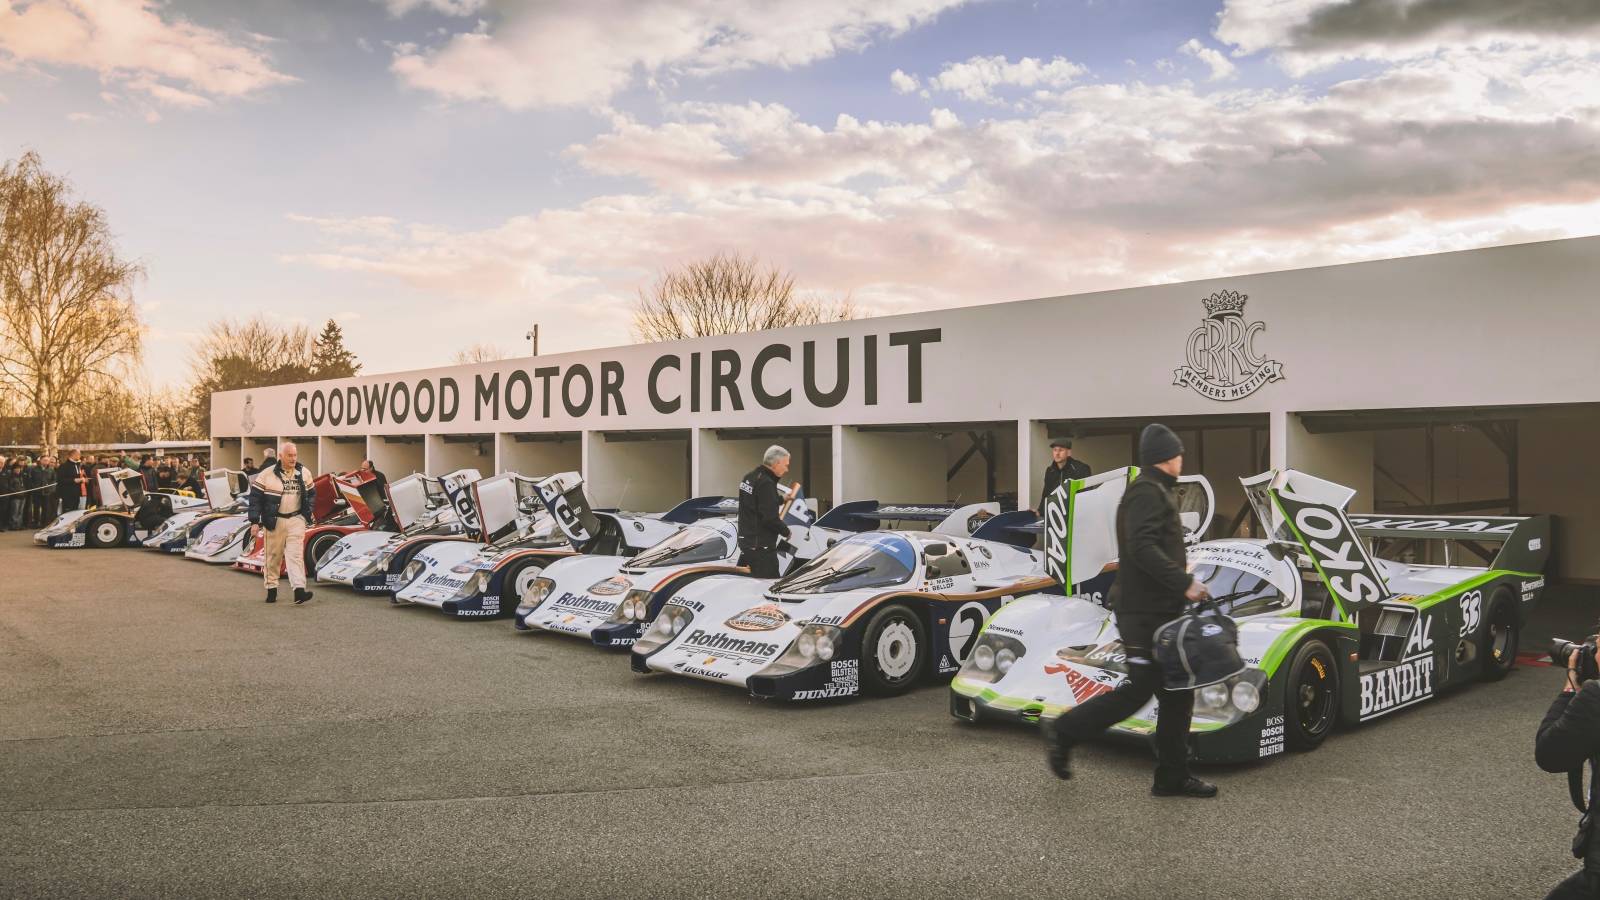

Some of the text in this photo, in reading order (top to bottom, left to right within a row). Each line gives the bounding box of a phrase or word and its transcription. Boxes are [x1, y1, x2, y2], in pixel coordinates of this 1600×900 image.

[294, 327, 942, 427] GOODWOOD MOTOR CIRCUIT
[1184, 365, 1271, 398] MEMBERS MEETING
[1047, 483, 1068, 585] KOAL
[1185, 546, 1265, 561] ewsweek
[973, 560, 990, 569] BOSS
[423, 573, 467, 589] Rothman
[669, 596, 705, 613] Shell
[808, 614, 842, 625] hell
[1459, 589, 1482, 637] 33
[960, 607, 983, 661] 2
[987, 623, 1025, 637] Newsweek
[1406, 614, 1434, 654] AL
[684, 629, 780, 657] Rothmans
[831, 659, 859, 669] BOSCH
[1090, 651, 1127, 664] SKO
[831, 668, 859, 677] BILSTEIN
[1360, 655, 1434, 716] BANDIT
[792, 686, 859, 700] DUNLOP
[1266, 715, 1285, 726] BOSS
[1261, 726, 1285, 737] BOSCH
[1260, 735, 1285, 746] SACHS
[1259, 743, 1285, 757] BILSTEIN
